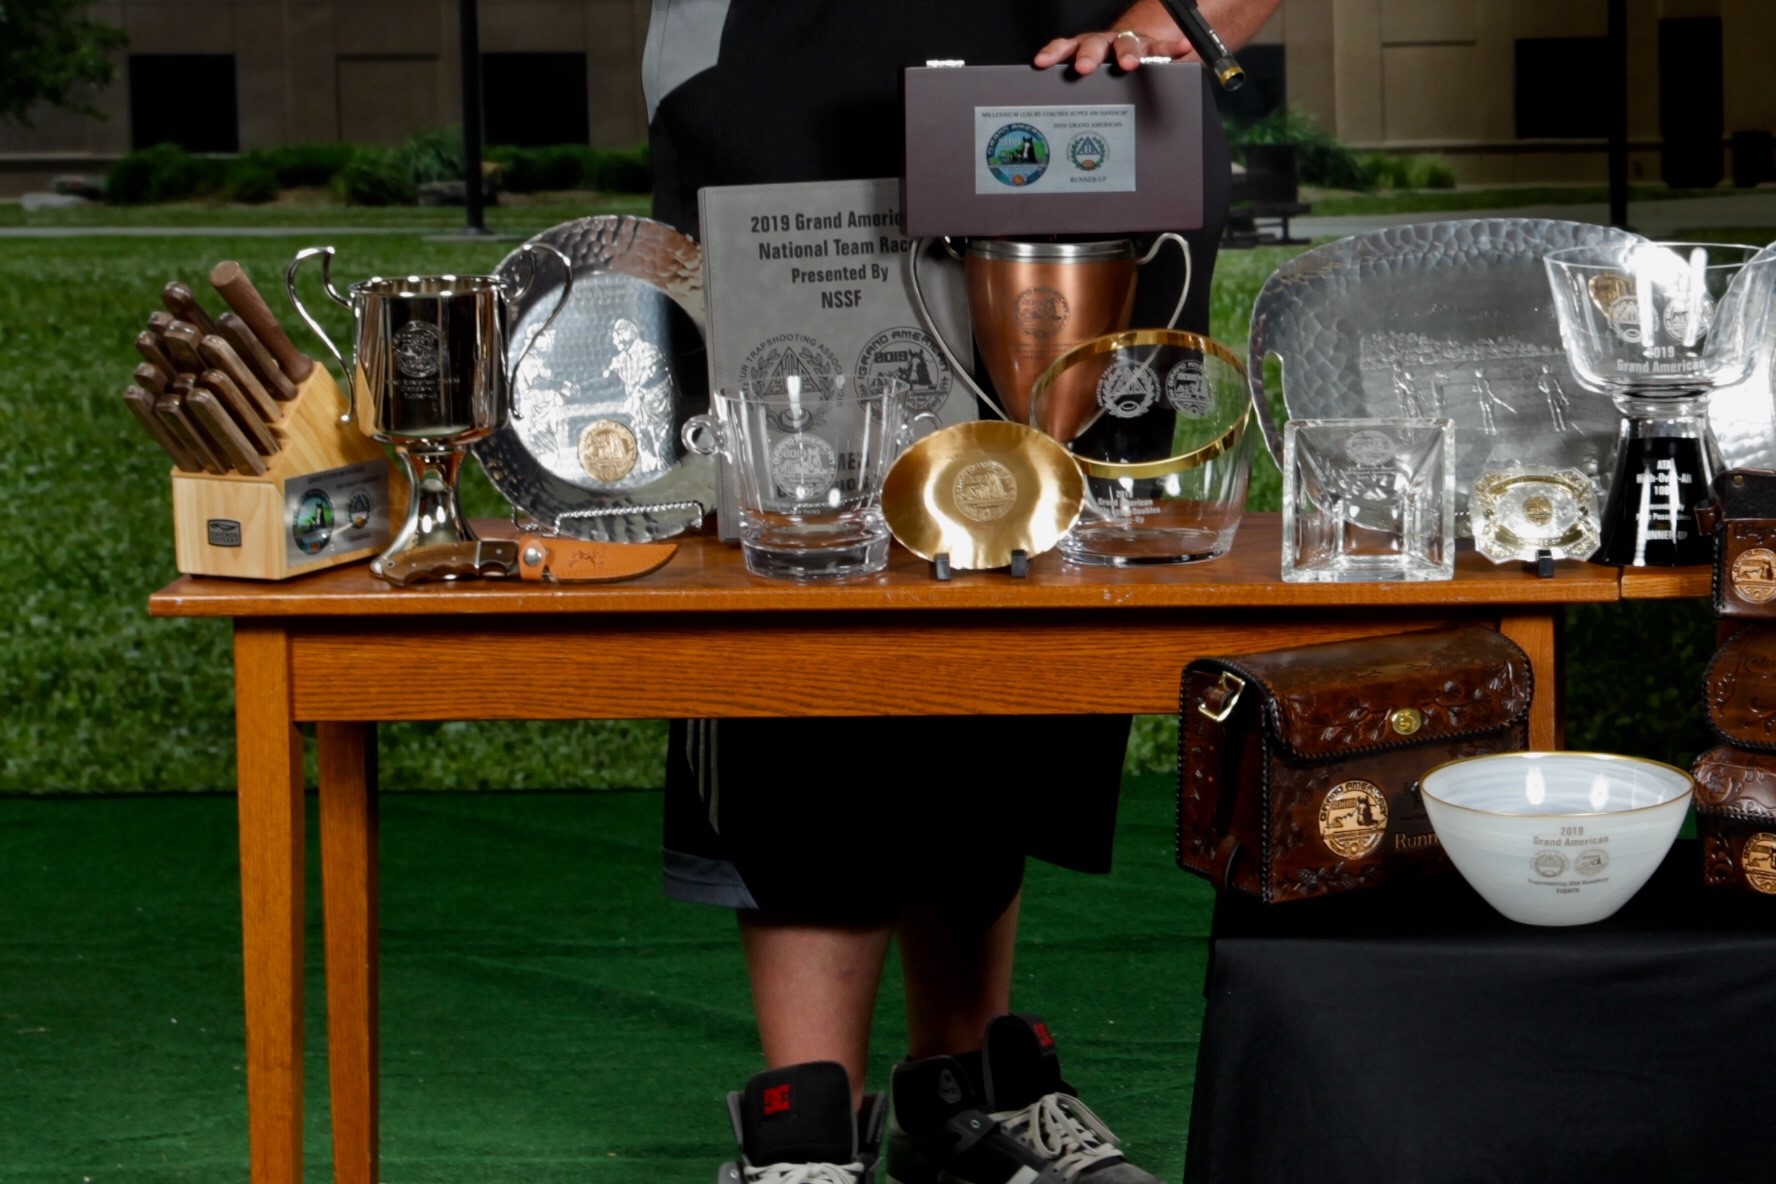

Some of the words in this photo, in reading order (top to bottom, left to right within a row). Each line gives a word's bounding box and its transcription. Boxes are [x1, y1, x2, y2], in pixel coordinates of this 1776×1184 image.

[750, 214, 790, 233] 2019
[795, 211, 842, 231] Grand
[847, 208, 901, 228] Americ
[758, 239, 829, 260] National
[833, 236, 875, 256] Team
[791, 264, 867, 284] Presented
[871, 263, 889, 282] By
[821, 289, 863, 309] NSSF
[747, 333, 818, 362] TRAPSHOOTING
[857, 334, 889, 379] GRAND
[891, 330, 948, 372] AMERICAN
[874, 350, 908, 364] 2019
[1616, 358, 1650, 373] Grand
[1652, 359, 1706, 374] American
[1120, 498, 1154, 507] Aerican
[1641, 530, 1688, 540] UNNER-UP
[1320, 785, 1344, 822] GRAND
[1345, 781, 1387, 816] AMERICAN
[1560, 826, 1585, 836] 2019
[1532, 836, 1561, 847] Grand
[1564, 836, 1609, 847] American
